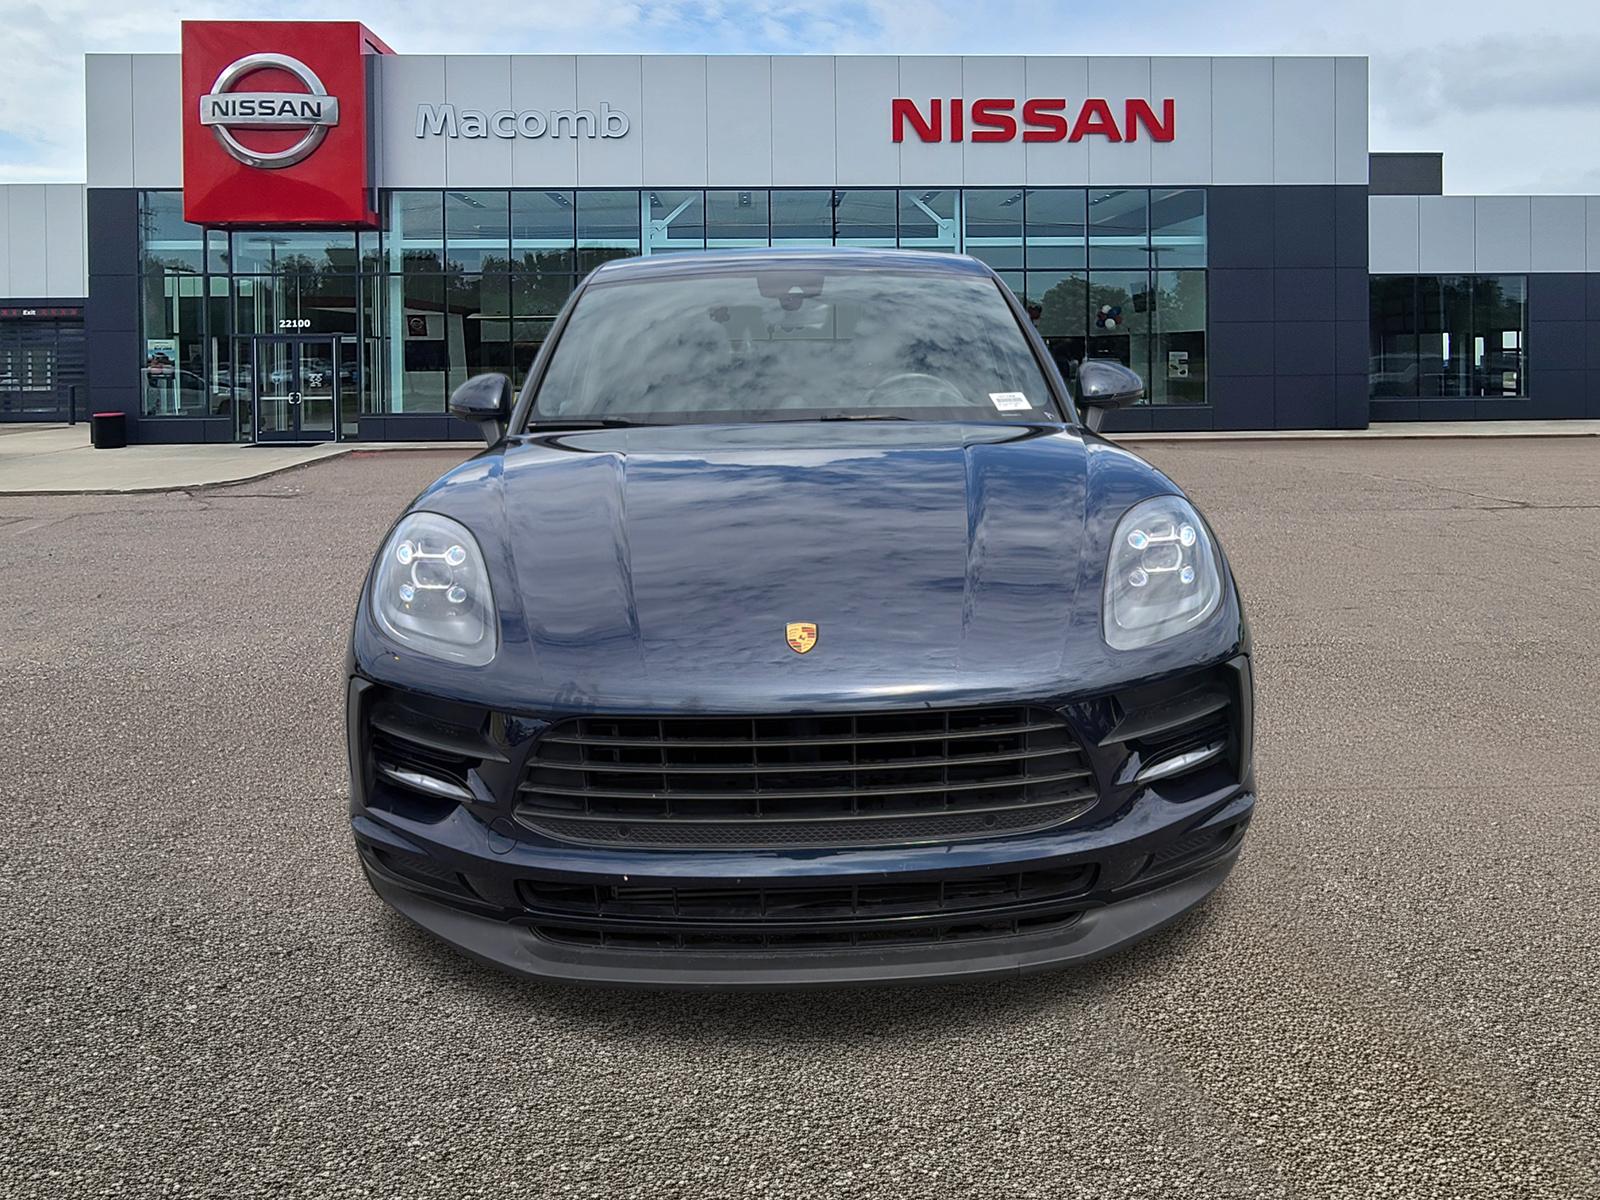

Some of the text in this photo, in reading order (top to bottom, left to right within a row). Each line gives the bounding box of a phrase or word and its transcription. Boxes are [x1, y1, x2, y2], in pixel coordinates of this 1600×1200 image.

[212, 100, 322, 117] NISSAN
[415, 102, 630, 138] Macomb
[892, 98, 1175, 143] NISSAN
[279, 319, 311, 328] 22100
